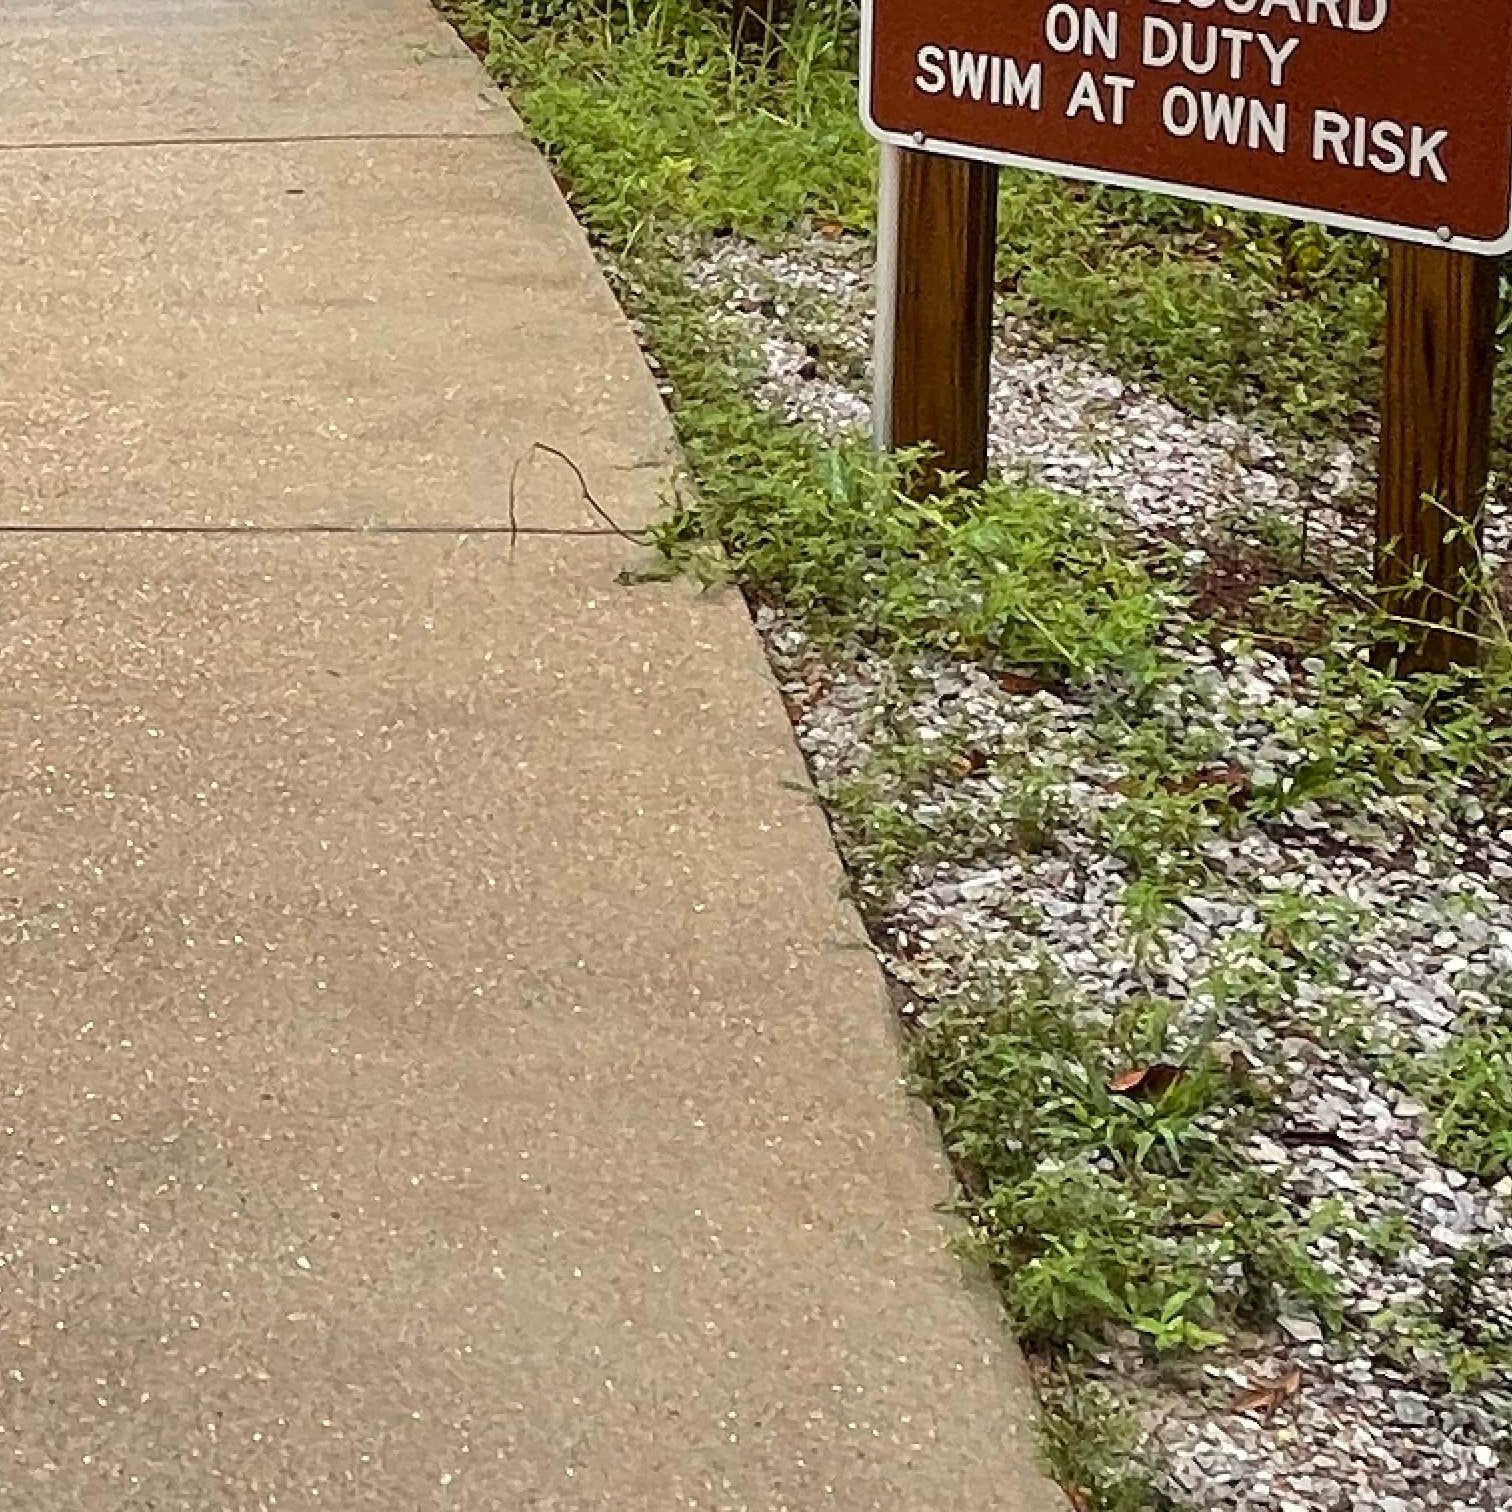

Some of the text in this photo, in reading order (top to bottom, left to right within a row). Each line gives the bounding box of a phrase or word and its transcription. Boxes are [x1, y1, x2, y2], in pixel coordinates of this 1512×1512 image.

[1046, 3, 1300, 86] ON DUTY
[915, 45, 1449, 183] SWIM AT OWN RISK
